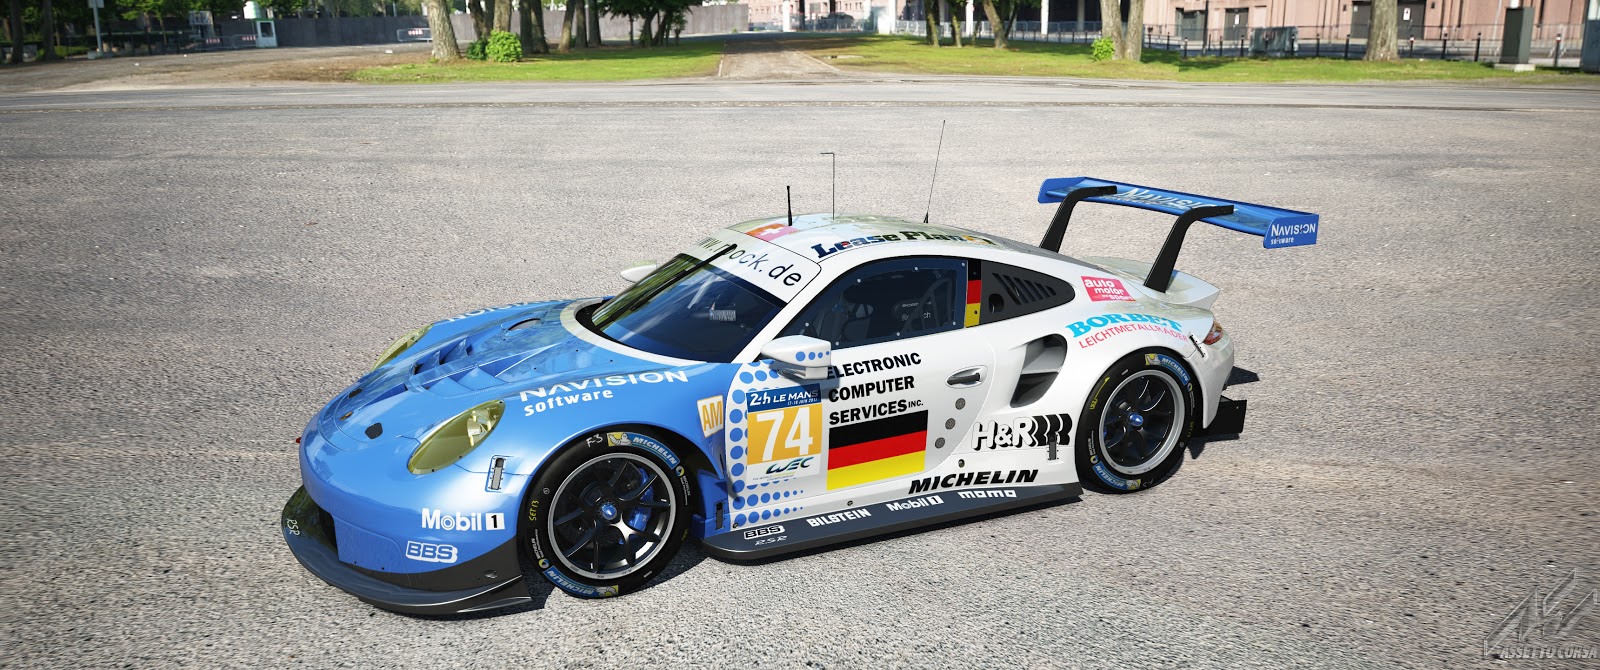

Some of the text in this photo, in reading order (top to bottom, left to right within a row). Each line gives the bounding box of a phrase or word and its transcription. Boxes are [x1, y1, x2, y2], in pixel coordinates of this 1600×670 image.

[1113, 187, 1238, 210] NAVISI
[1271, 223, 1316, 237] NAVISION
[811, 234, 896, 259] Lease
[1084, 279, 1116, 288] auto
[1093, 287, 1125, 296] motor
[1066, 313, 1183, 338] BORBET
[827, 353, 922, 379] ELECTRONIC
[1161, 357, 1189, 383] MICHELIN
[519, 370, 689, 402] NAVISION
[773, 394, 786, 403] LE
[788, 390, 818, 401] MANS
[828, 375, 915, 402] COMPUTER
[524, 389, 614, 417] software
[829, 399, 924, 425] SERVICES INC.
[702, 400, 723, 432] AM
[756, 406, 814, 463] 74
[971, 416, 1038, 451] H&R
[632, 436, 678, 466] MICHELIN
[766, 456, 815, 474] WEC
[908, 469, 1039, 495] MICHELIN
[886, 498, 929, 511] Mobil
[421, 508, 483, 531] Mobil
[806, 508, 872, 527] BILSTEIN
[744, 525, 785, 539] BBS
[406, 541, 457, 563] BBS
[547, 570, 595, 595] MICHELIN
